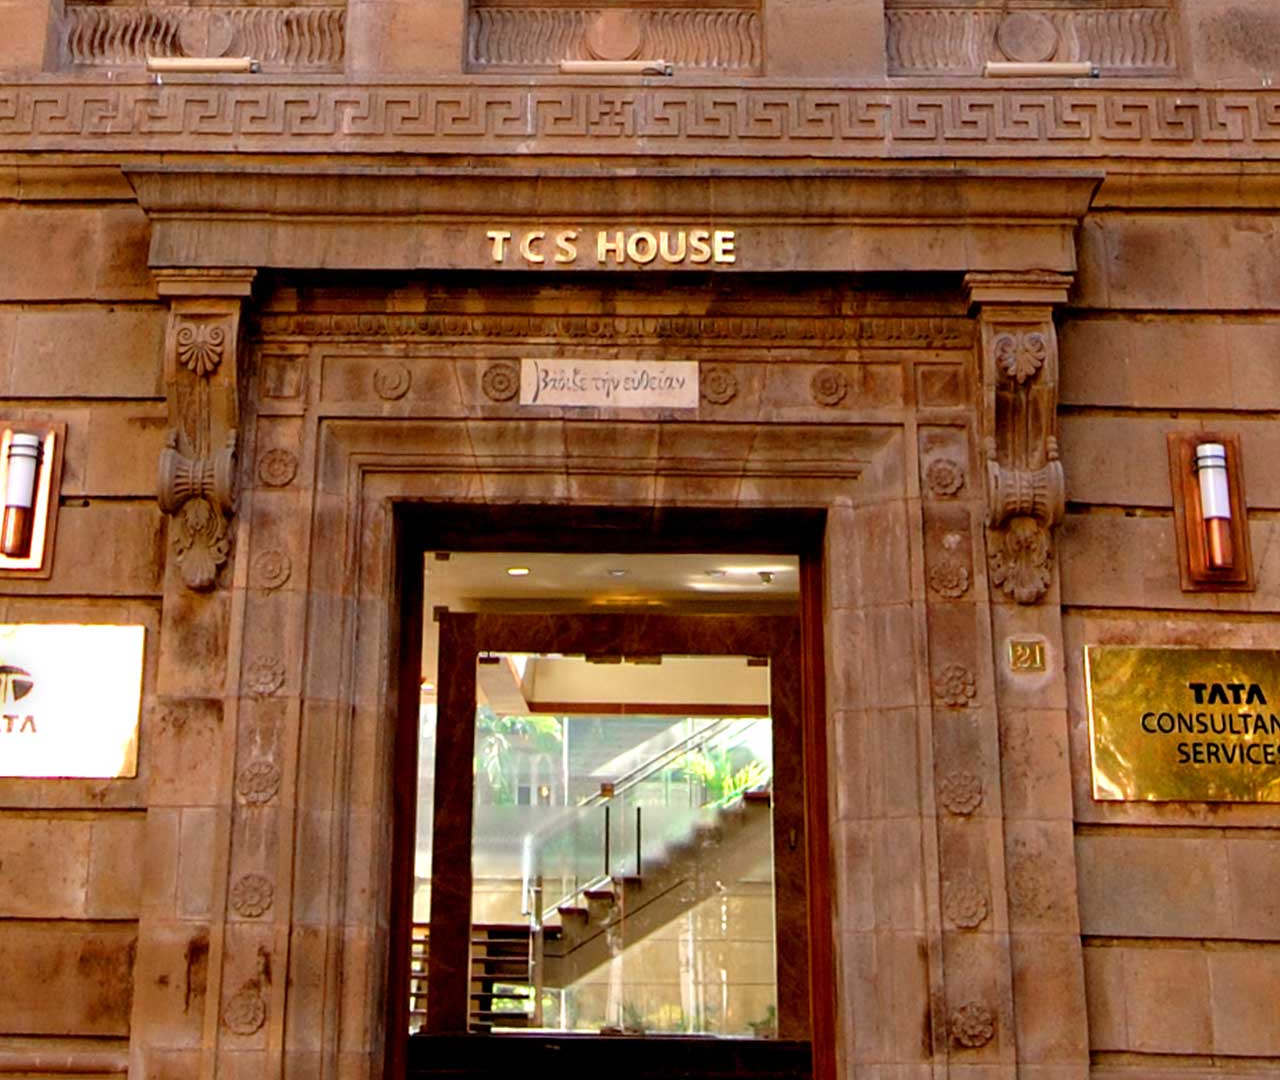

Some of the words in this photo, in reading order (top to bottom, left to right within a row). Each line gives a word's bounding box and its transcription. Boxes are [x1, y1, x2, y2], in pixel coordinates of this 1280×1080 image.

[597, 230, 736, 264] HOUSE
[1015, 644, 1041, 668] 21
[1189, 682, 1267, 705] TATA
